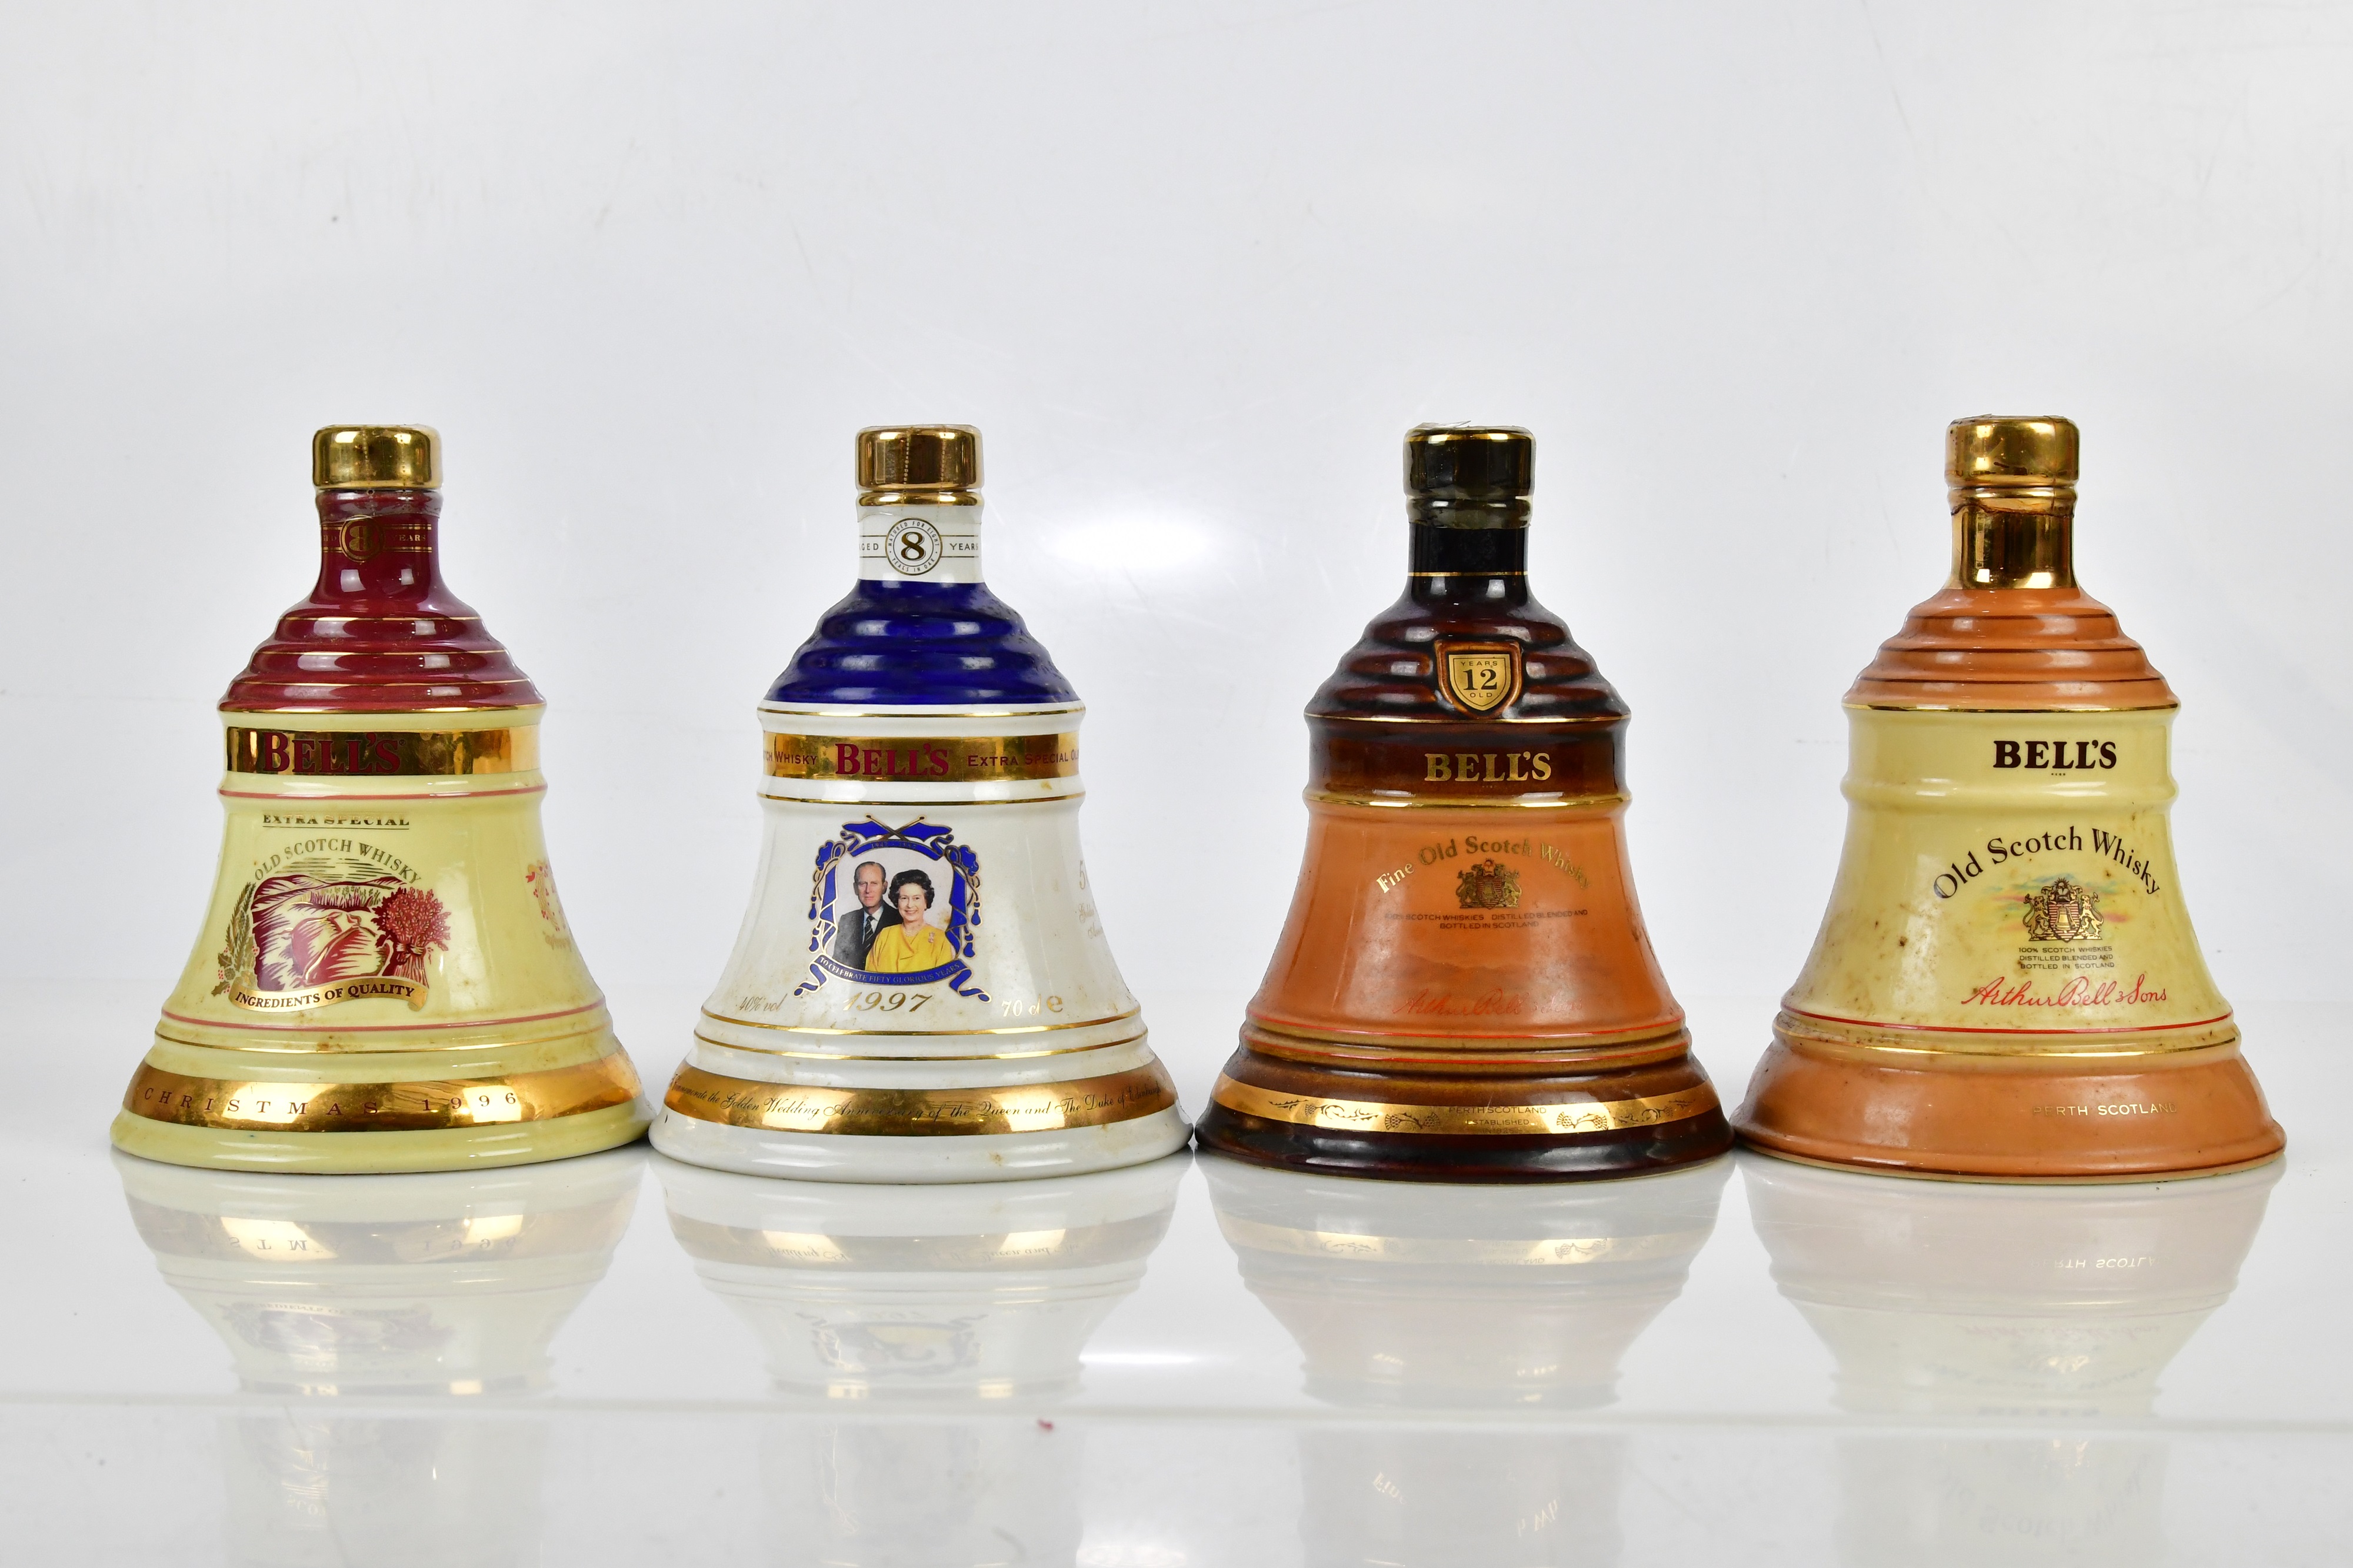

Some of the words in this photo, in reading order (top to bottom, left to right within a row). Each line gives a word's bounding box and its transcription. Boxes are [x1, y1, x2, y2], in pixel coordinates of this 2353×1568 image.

[888, 521, 908, 547] MATURED
[926, 526, 939, 546] EIGHT
[901, 531, 926, 561] 8
[949, 542, 979, 551] YEARS
[891, 558, 909, 573] YEARS
[924, 558, 935, 570] OAK
[1463, 669, 1498, 690] 12
[263, 732, 401, 774] BELL'S
[835, 743, 949, 776] BELL'S
[968, 755, 1019, 766] EXTRA
[1025, 752, 1069, 765] SPECIAL
[1993, 739, 2117, 769] BELL'S
[1424, 751, 1552, 782] BELL'S
[263, 814, 319, 824] EXTRA
[324, 815, 409, 826] SPECIAL
[254, 853, 281, 881] OLD
[284, 838, 353, 860] SCOTCH
[358, 842, 422, 883] WHISKY
[1376, 861, 1415, 893] Fine
[1418, 839, 1458, 866] Old
[1465, 836, 1532, 858] Scotch
[1540, 842, 1592, 890] Whisky
[1934, 850, 1984, 899] Old
[1987, 825, 2082, 865] Scotch
[2092, 828, 2160, 895] Whisky
[1492, 920, 1539, 929] SCOTLAND
[1536, 910, 1572, 919] BLENDED
[819, 956, 829, 966] TO
[935, 963, 960, 978] YEARS
[235, 992, 321, 1008] INGREDIENTS
[324, 988, 344, 1000] OF
[348, 983, 415, 998] QUALITY
[843, 992, 933, 1012] 1997
[1961, 976, 2058, 1006] Arthur
[2057, 976, 2117, 1006] Bell
[2122, 973, 2167, 1003] Sons
[739, 996, 764, 1012] 40%
[764, 993, 788, 1012] vol
[1001, 999, 1024, 1017] 70
[144, 1087, 379, 1116] CHRISTMAS
[422, 1092, 516, 1112] 1996
[708, 1090, 721, 1103] the
[720, 1091, 761, 1111] Golden
[764, 1097, 820, 1120] Wedding
[928, 1105, 945, 1122] of
[949, 1103, 970, 1117] the
[976, 1100, 1020, 1117] Queen
[1025, 1101, 1051, 1115] and
[1054, 1097, 1081, 1115] The
[1082, 1093, 1115, 1110] Duke
[1117, 1092, 1126, 1109] of
[2032, 1105, 2088, 1116] PERTH
[2098, 1103, 2177, 1116] SCOTLAND
